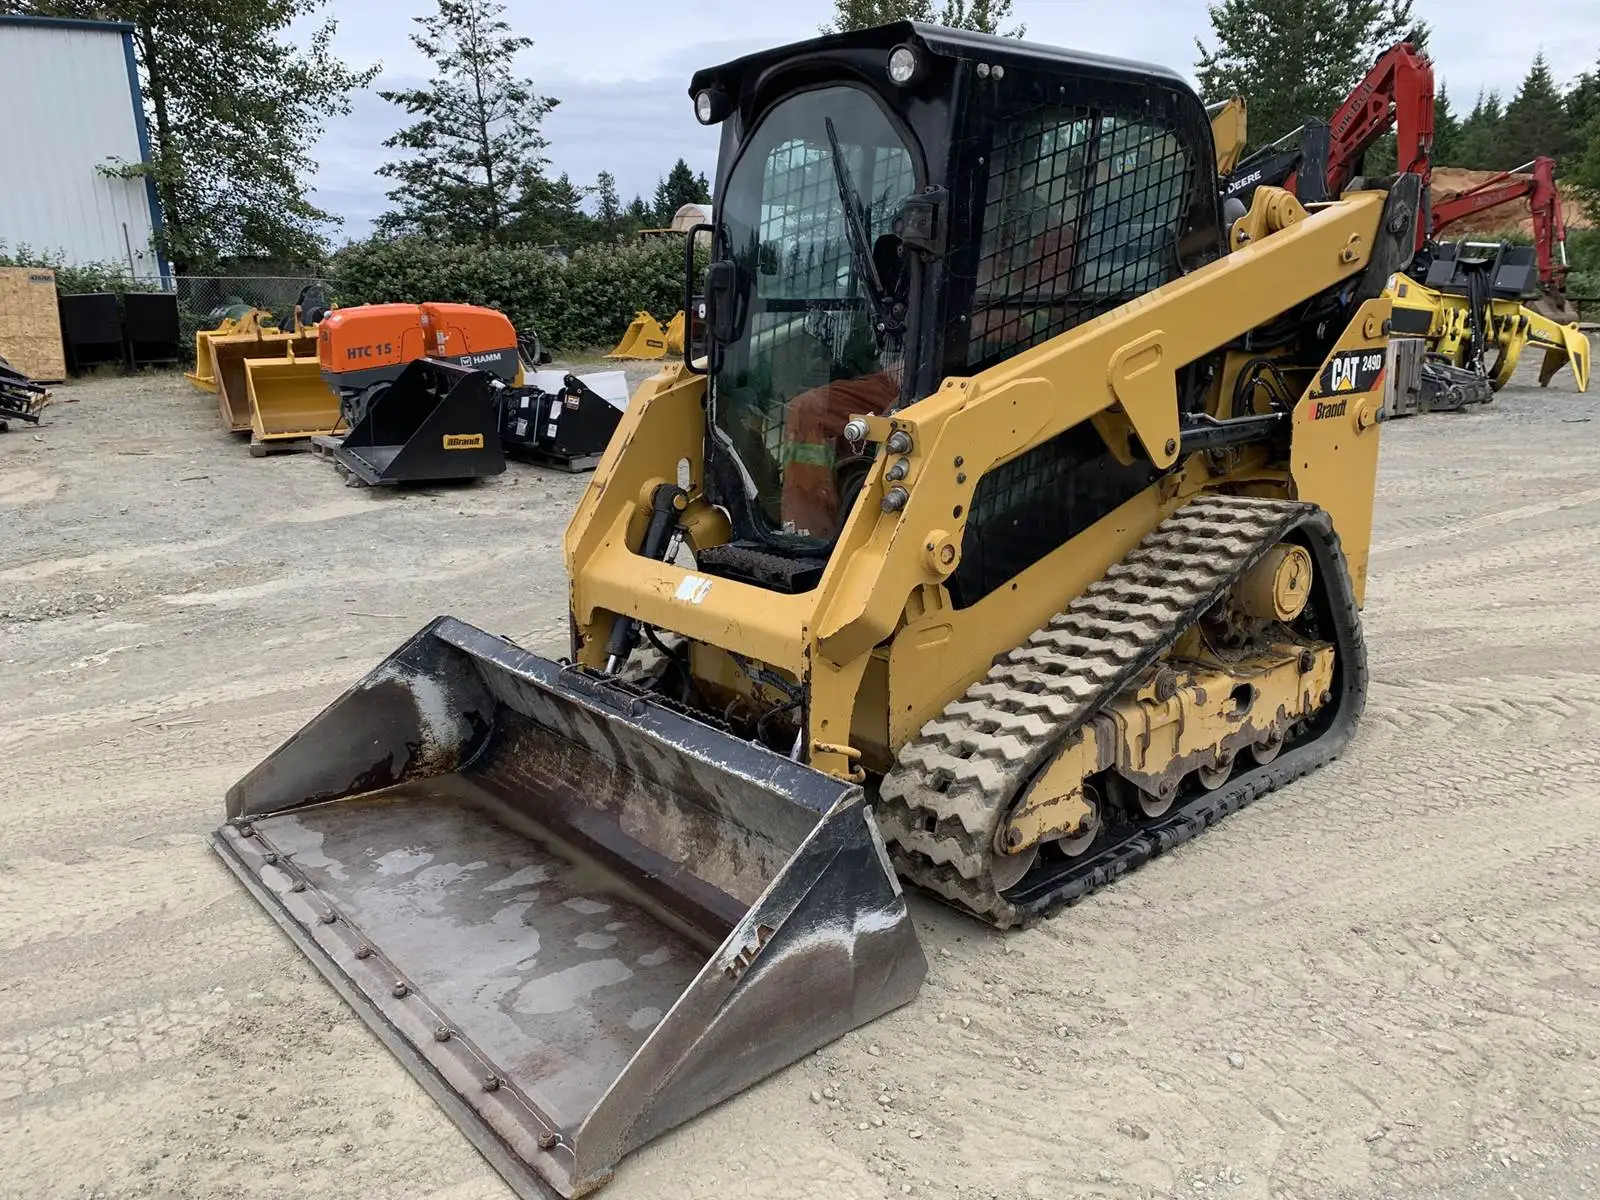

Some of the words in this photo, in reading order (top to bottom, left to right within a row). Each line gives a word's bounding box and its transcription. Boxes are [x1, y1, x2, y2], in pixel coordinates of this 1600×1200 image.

[1116, 152, 1138, 175] CAT
[1227, 170, 1262, 194] DEERE
[347, 345, 372, 360] HTC
[376, 343, 392, 356] 15
[473, 352, 502, 364] HAMM
[1331, 356, 1360, 391] CAT
[1362, 354, 1382, 372] 249D
[1314, 399, 1347, 420] Brandt
[453, 437, 480, 446] Brandt
[724, 924, 776, 981] HLA
